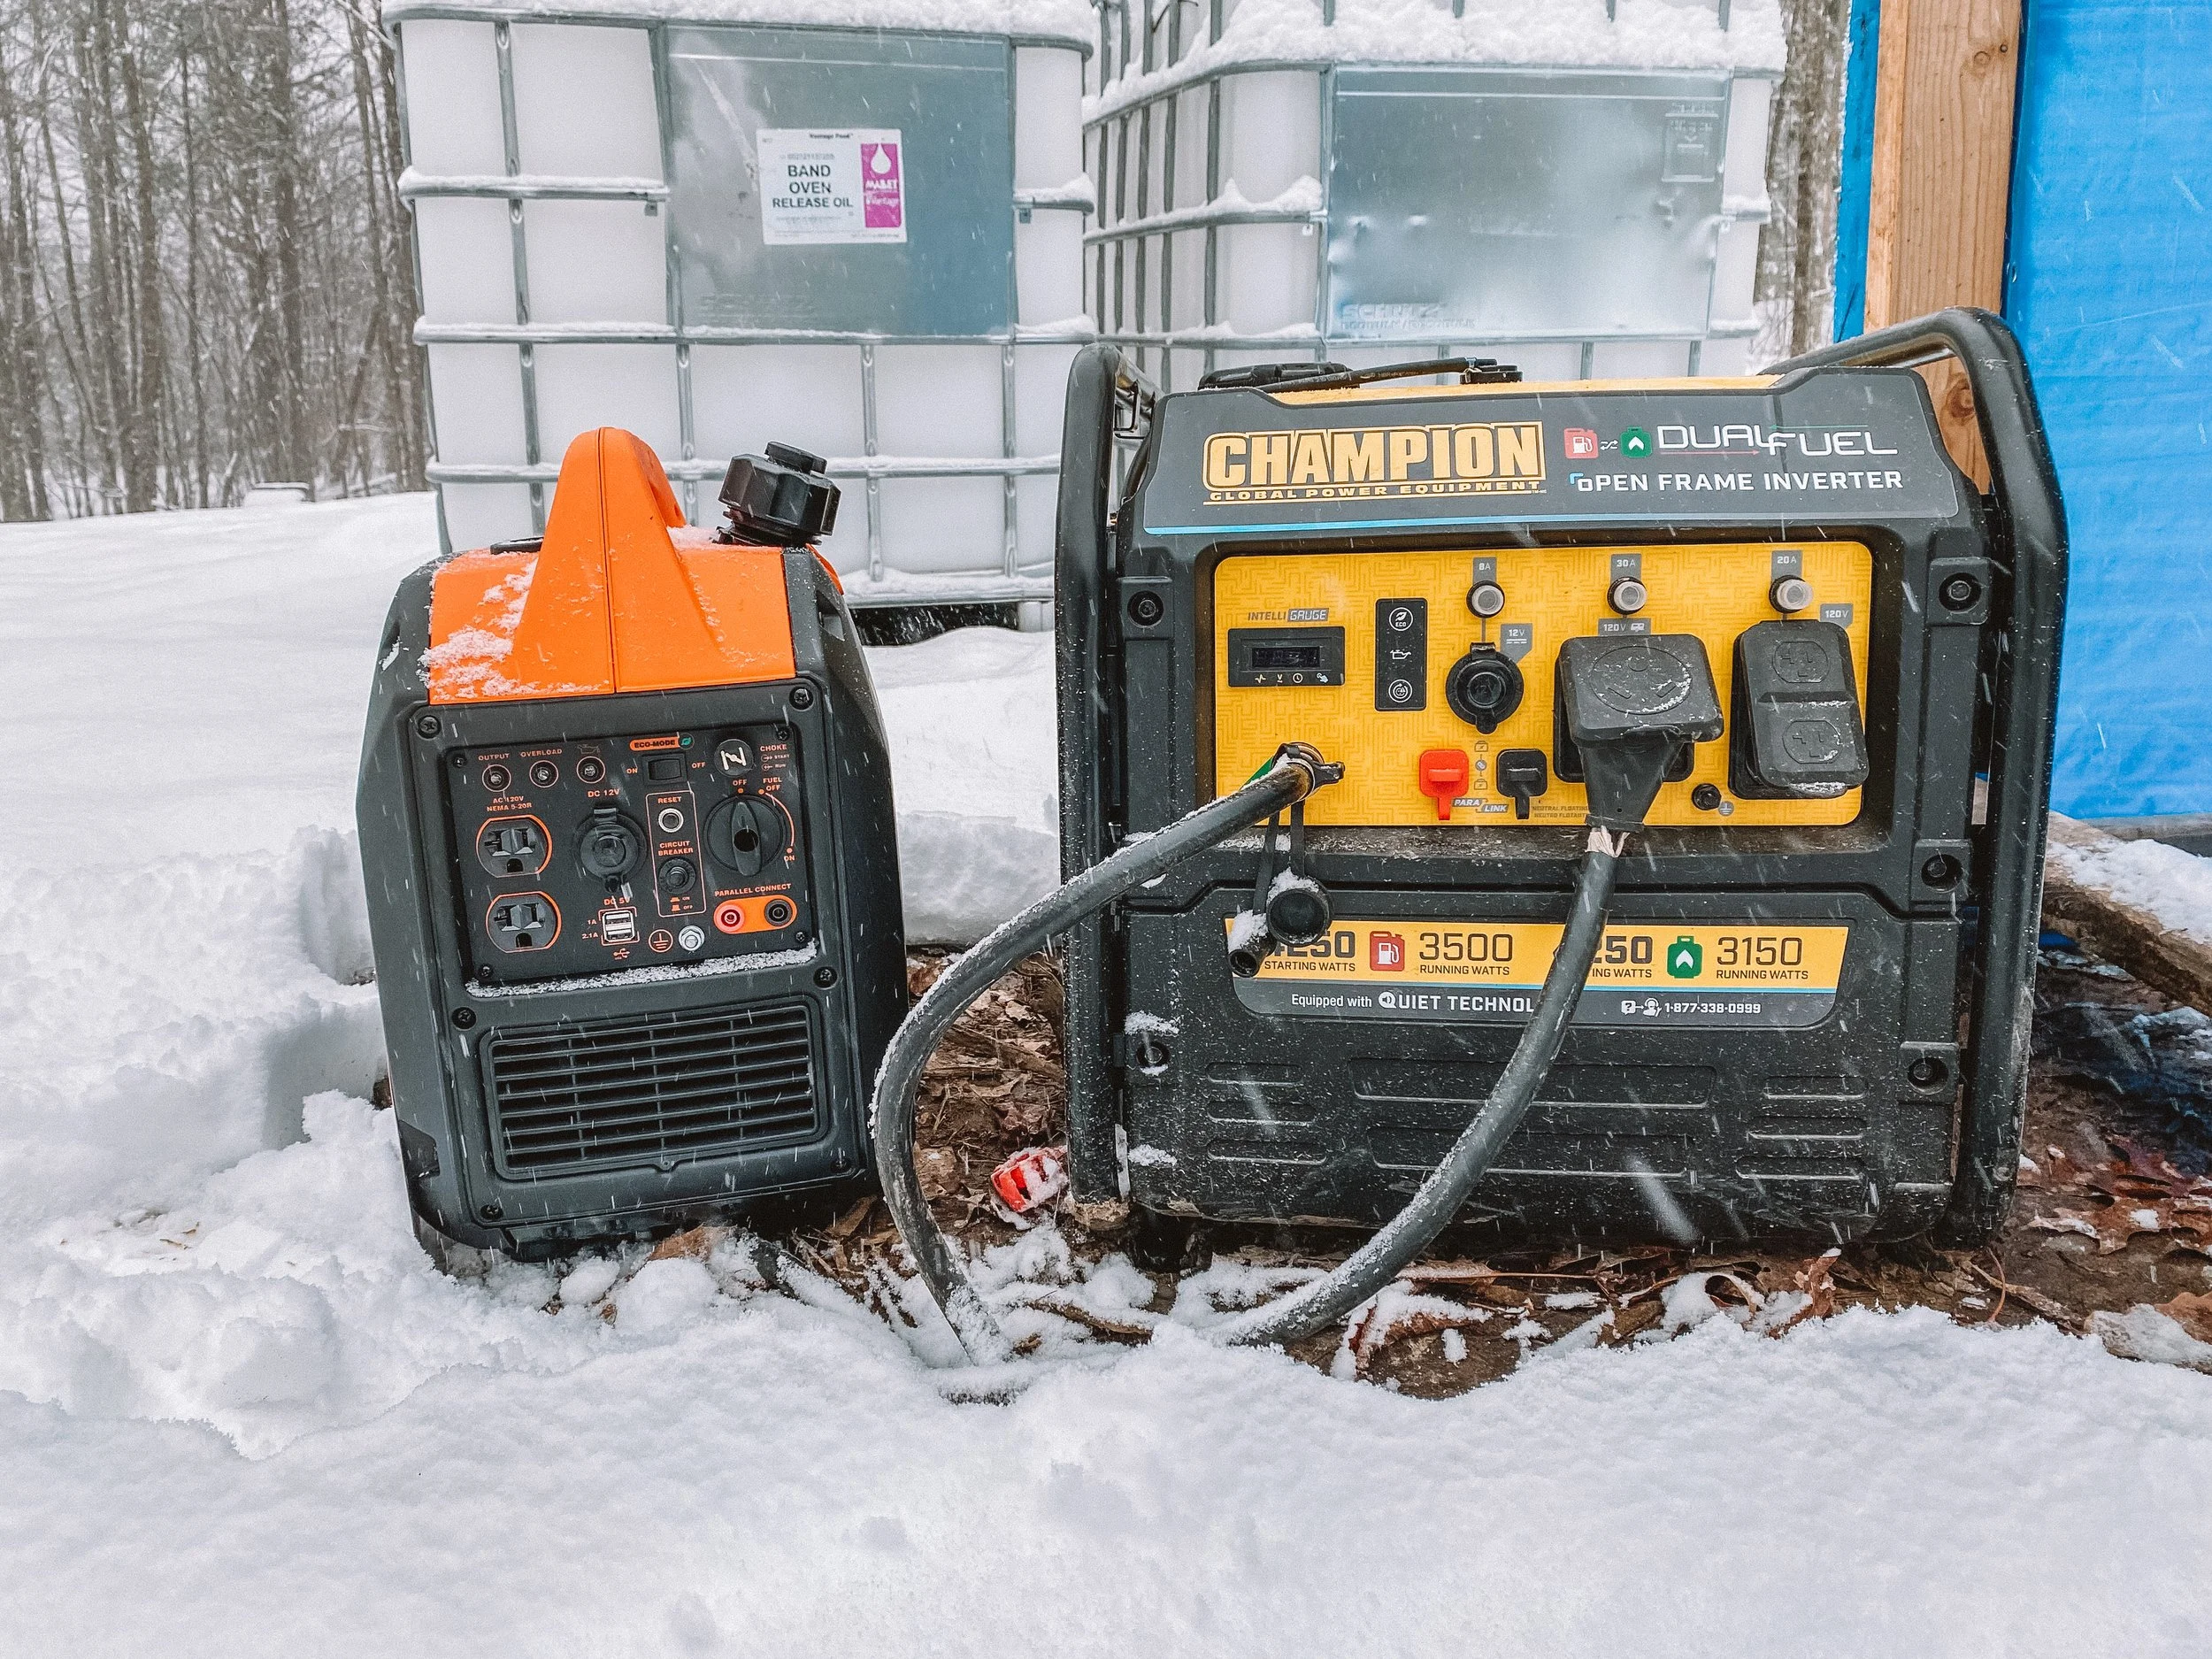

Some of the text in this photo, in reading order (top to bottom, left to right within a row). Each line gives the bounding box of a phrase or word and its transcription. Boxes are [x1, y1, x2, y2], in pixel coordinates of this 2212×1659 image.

[787, 165, 831, 177] BAND
[789, 181, 831, 193] OVEN
[772, 197, 853, 208] RELEASE OIL
[1657, 425, 1899, 456] DUAL FUEL
[1205, 422, 1543, 488] CHAMPION
[1577, 471, 1904, 492] OPEN FRAME INVERTER
[1210, 480, 1540, 502] GLOBAL POWER EQUIPMENT
[634, 740, 676, 749] ECO-MODE
[520, 749, 563, 757] OVERLOAD
[657, 848, 694, 856] BREAKER
[714, 884, 792, 897] PARALLEL CONNECT
[1419, 933, 1514, 962] 3500
[1717, 937, 1801, 966] 3150
[1264, 961, 1356, 972] STARTING WATTS
[1419, 964, 1510, 976] RUNNING WATTS
[1614, 969, 1652, 978] WATTS
[1717, 970, 1809, 980] RUNNING WATTS
[1291, 995, 1372, 1009] Equipped with
[1379, 992, 1534, 1013] QUIET TECHNOL
